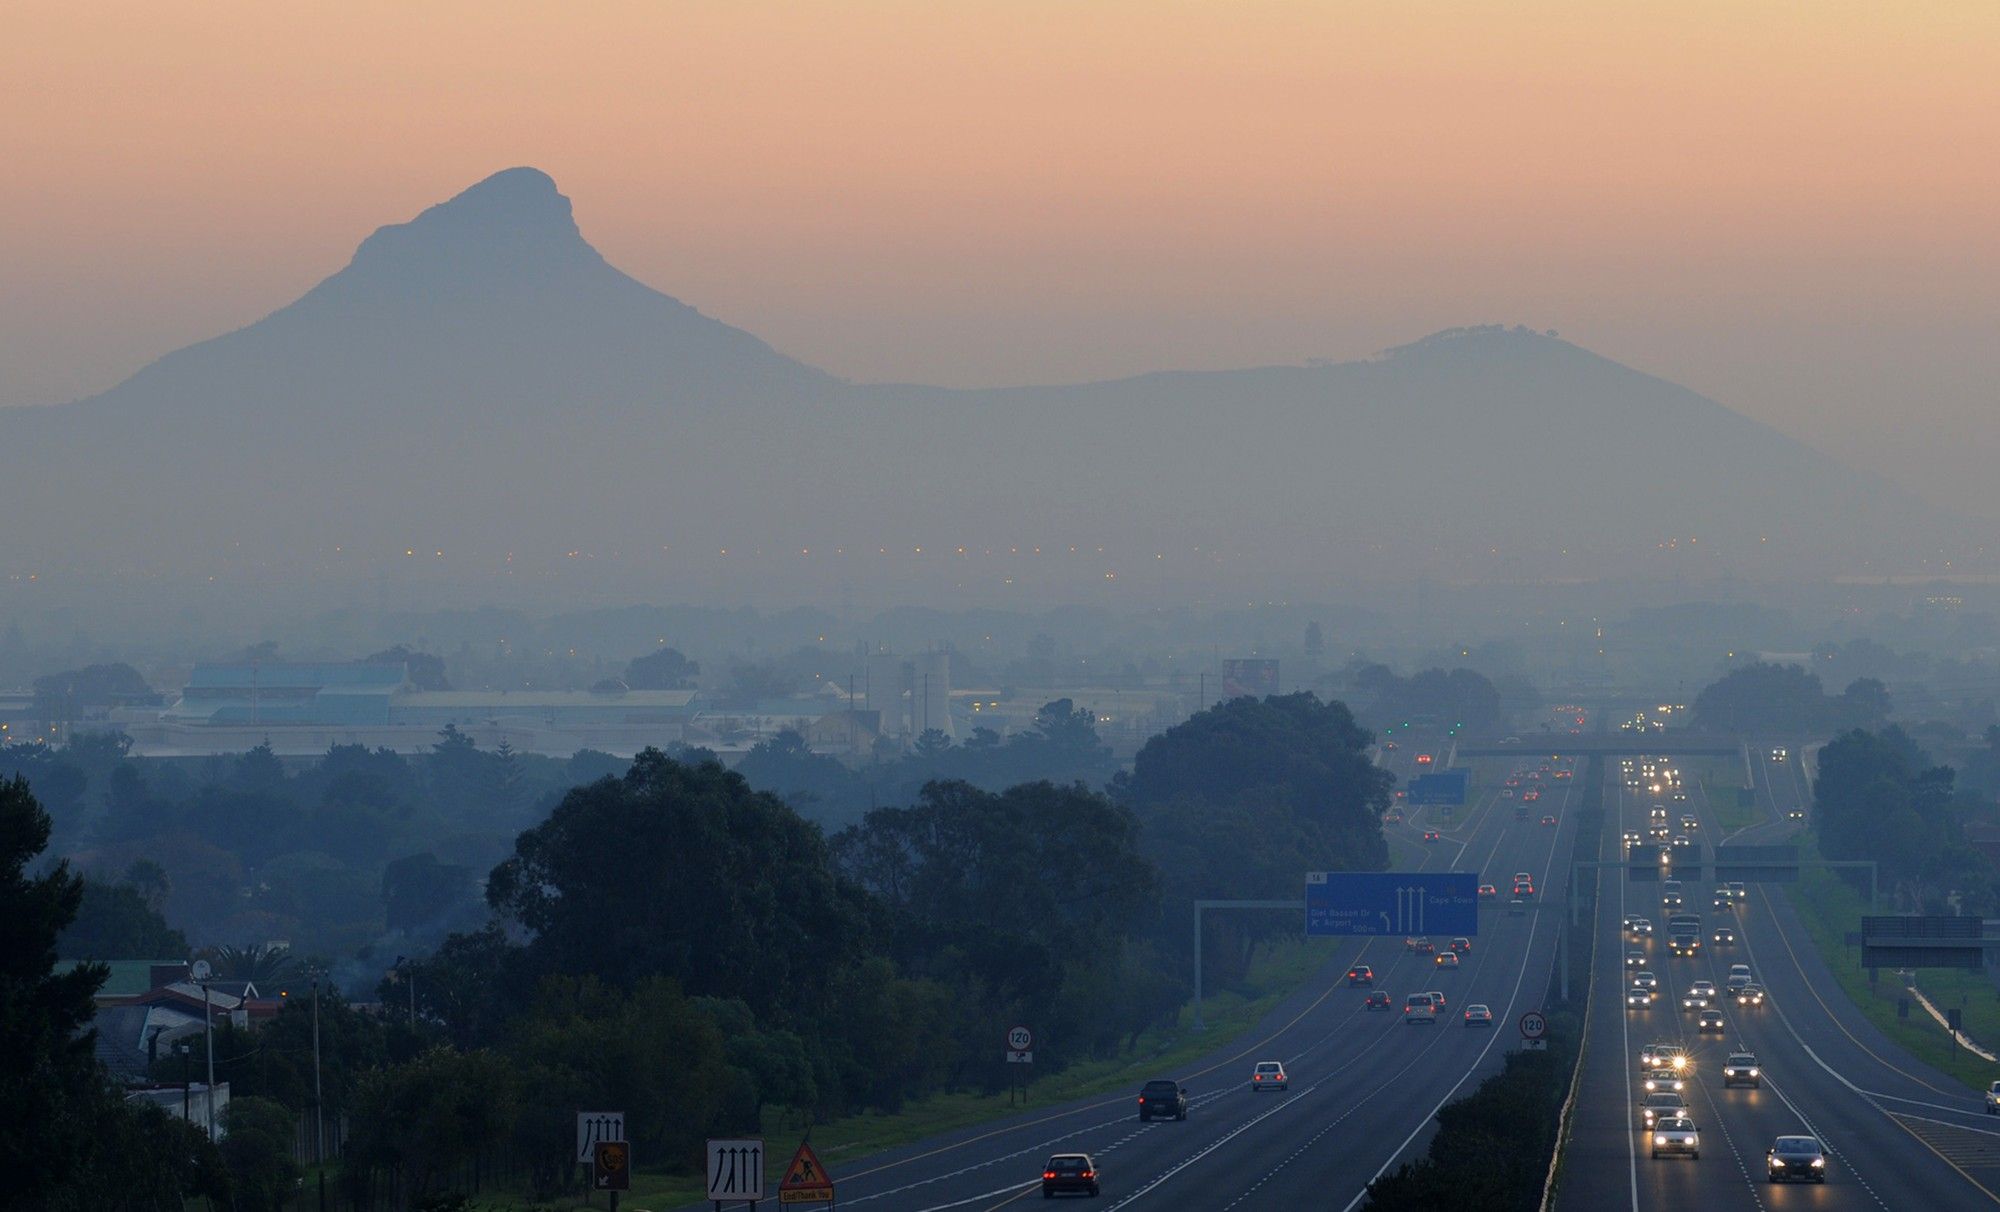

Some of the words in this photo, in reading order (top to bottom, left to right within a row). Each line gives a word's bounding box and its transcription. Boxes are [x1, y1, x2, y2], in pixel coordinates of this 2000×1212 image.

[1429, 896, 1449, 905] Cape
[1454, 896, 1473, 904] Town
[1324, 919, 1350, 928] Airport
[1524, 1020, 1542, 1030] 120
[1011, 1032, 1029, 1043] 120
